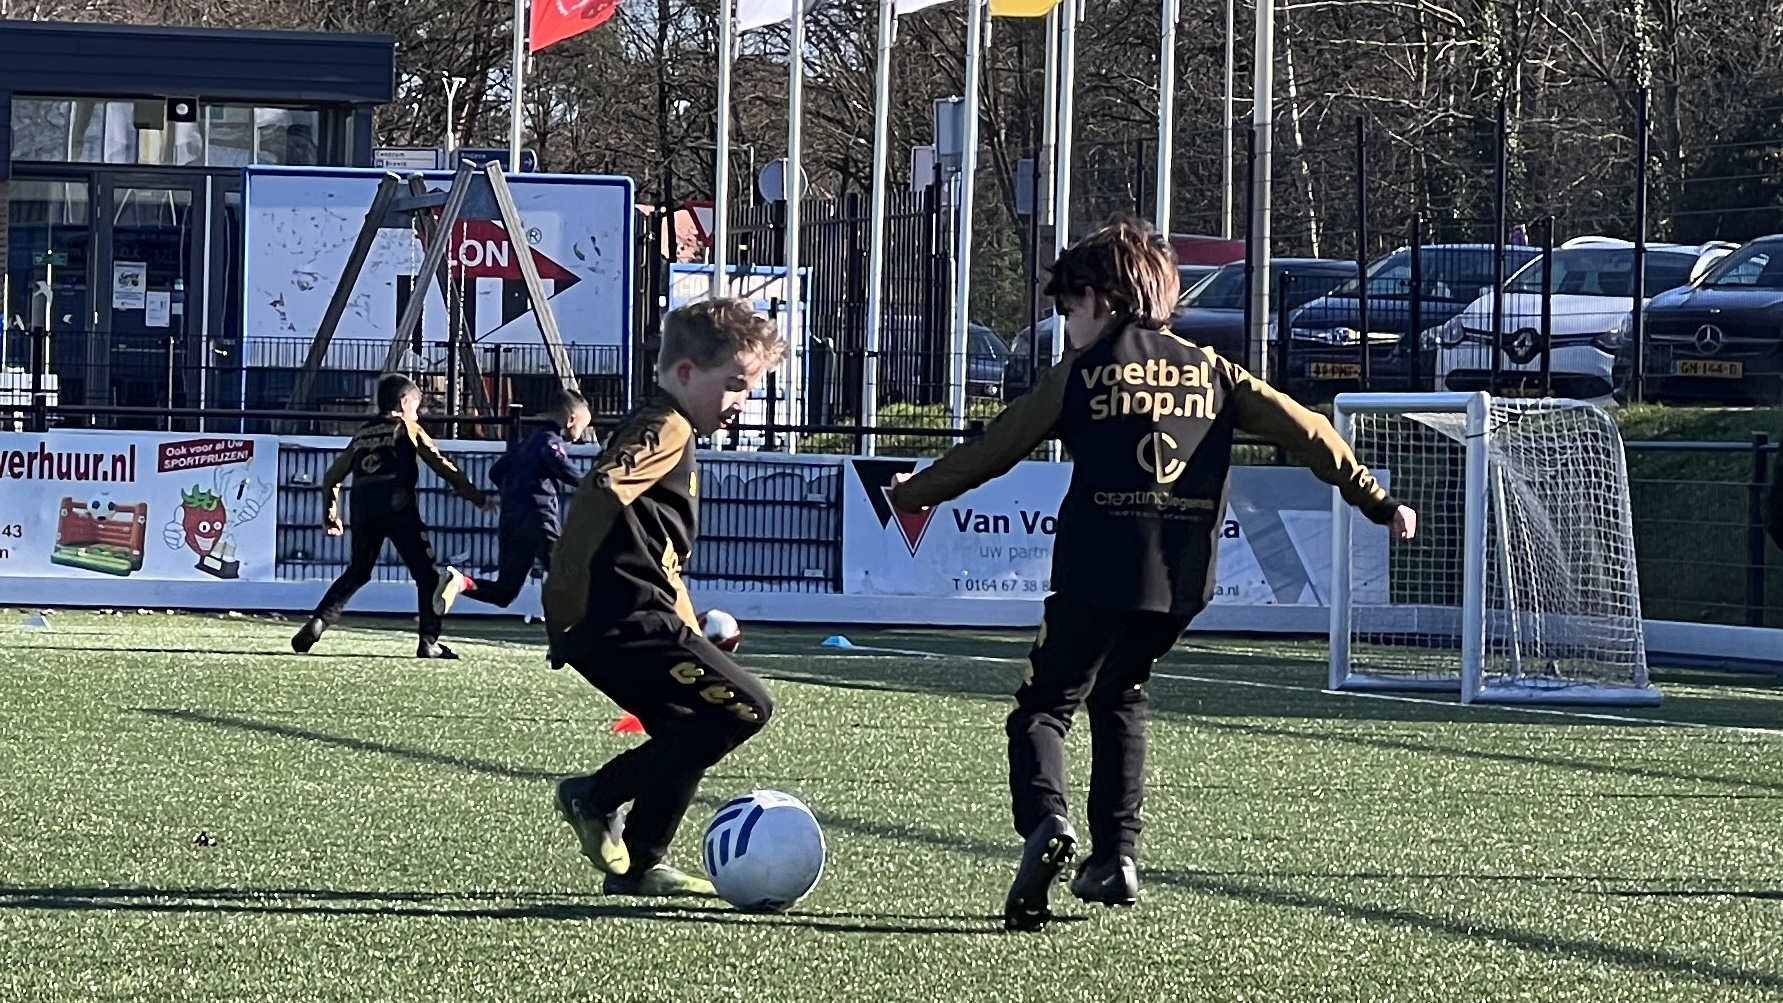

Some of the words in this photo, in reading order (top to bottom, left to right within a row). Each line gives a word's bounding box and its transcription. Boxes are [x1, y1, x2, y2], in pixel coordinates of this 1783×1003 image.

[1081, 359, 1213, 389] voetbal
[1089, 386, 1216, 422] shop.nl
[165, 445, 187, 456] Ook
[189, 443, 213, 453] voor
[227, 440, 244, 448] Uw
[163, 450, 249, 469] SPORTPRIJZEN!
[952, 508, 1010, 534] Van
[2, 524, 22, 538] 43
[979, 546, 1002, 558] uw
[952, 578, 960, 590] T
[965, 579, 997, 591] 0164
[1001, 579, 1018, 592] 67
[1022, 579, 1037, 592] 38
[1042, 579, 1051, 592] 8
